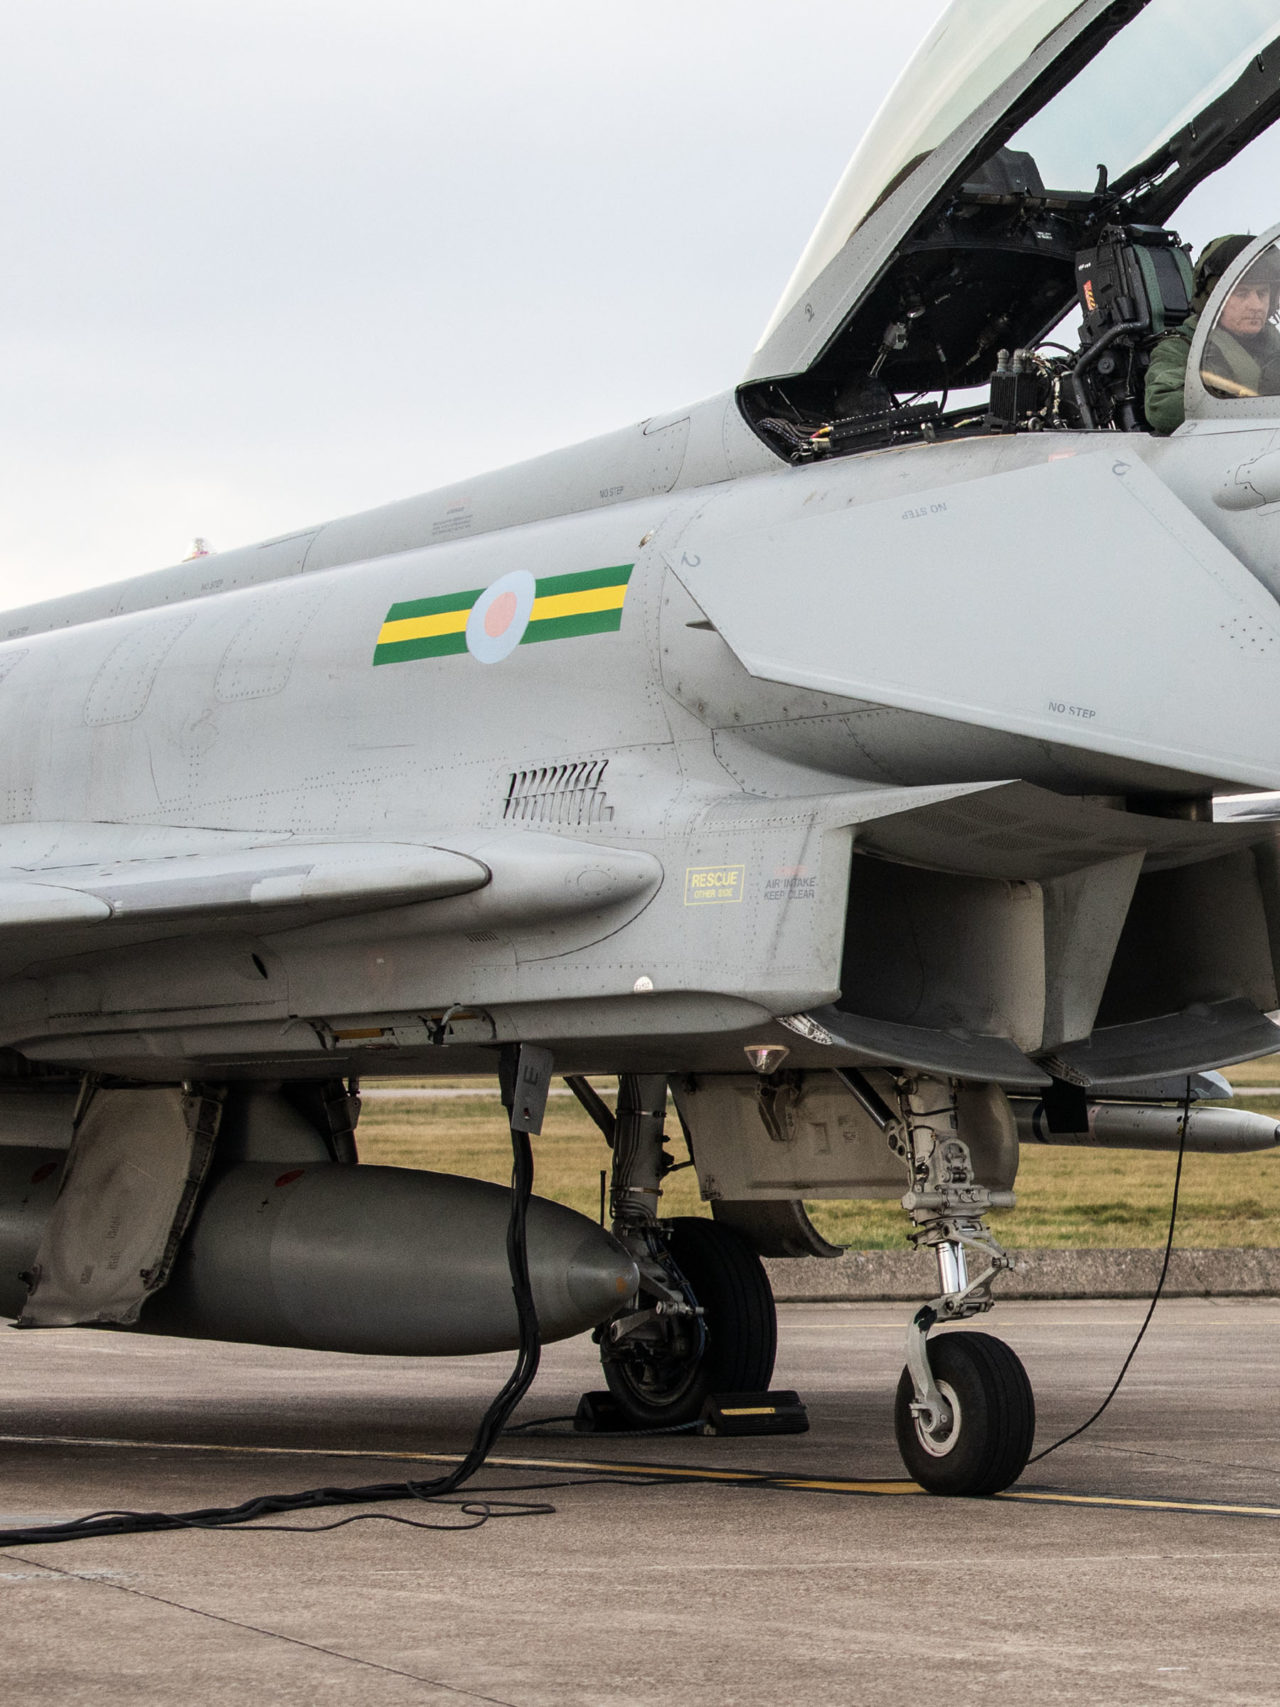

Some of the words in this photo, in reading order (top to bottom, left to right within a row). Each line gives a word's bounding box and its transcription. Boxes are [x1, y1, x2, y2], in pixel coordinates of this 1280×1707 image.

[600, 489, 608, 498] NO
[609, 486, 624, 497] STEP
[902, 507, 927, 520] STEP
[930, 503, 947, 513] NO
[1049, 702, 1066, 713] NO
[1069, 706, 1096, 718] STEP
[691, 871, 739, 888] RESCUE
[765, 879, 780, 889] AIR
[784, 877, 816, 888] INTAKE
[694, 889, 716, 898] OTHER
[718, 888, 733, 897] SIDE
[764, 891, 784, 900] KEEP
[788, 889, 815, 899] CLEAR
